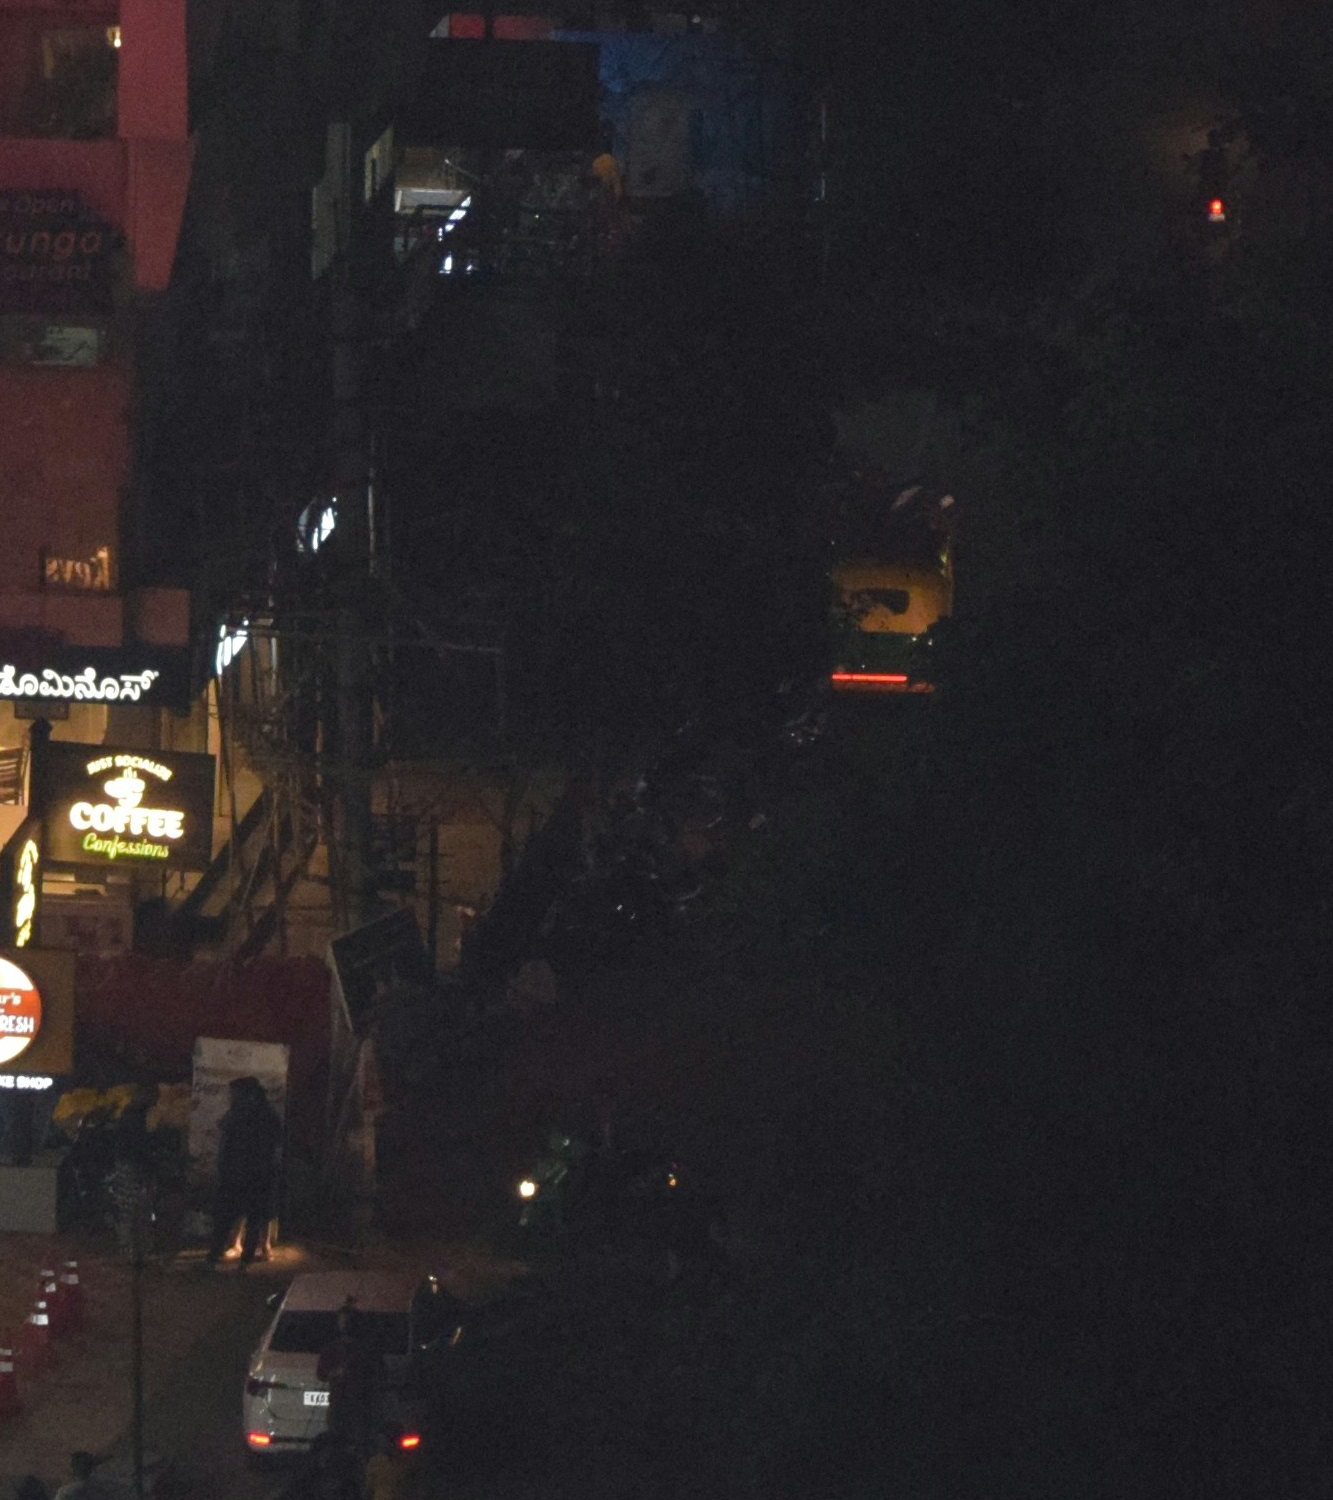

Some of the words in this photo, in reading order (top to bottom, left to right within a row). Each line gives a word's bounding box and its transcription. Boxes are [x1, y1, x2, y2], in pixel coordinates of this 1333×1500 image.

[69, 801, 185, 839] COFFEE
[82, 832, 169, 859] Confessions
[16, 1075, 54, 1091] SHOP
